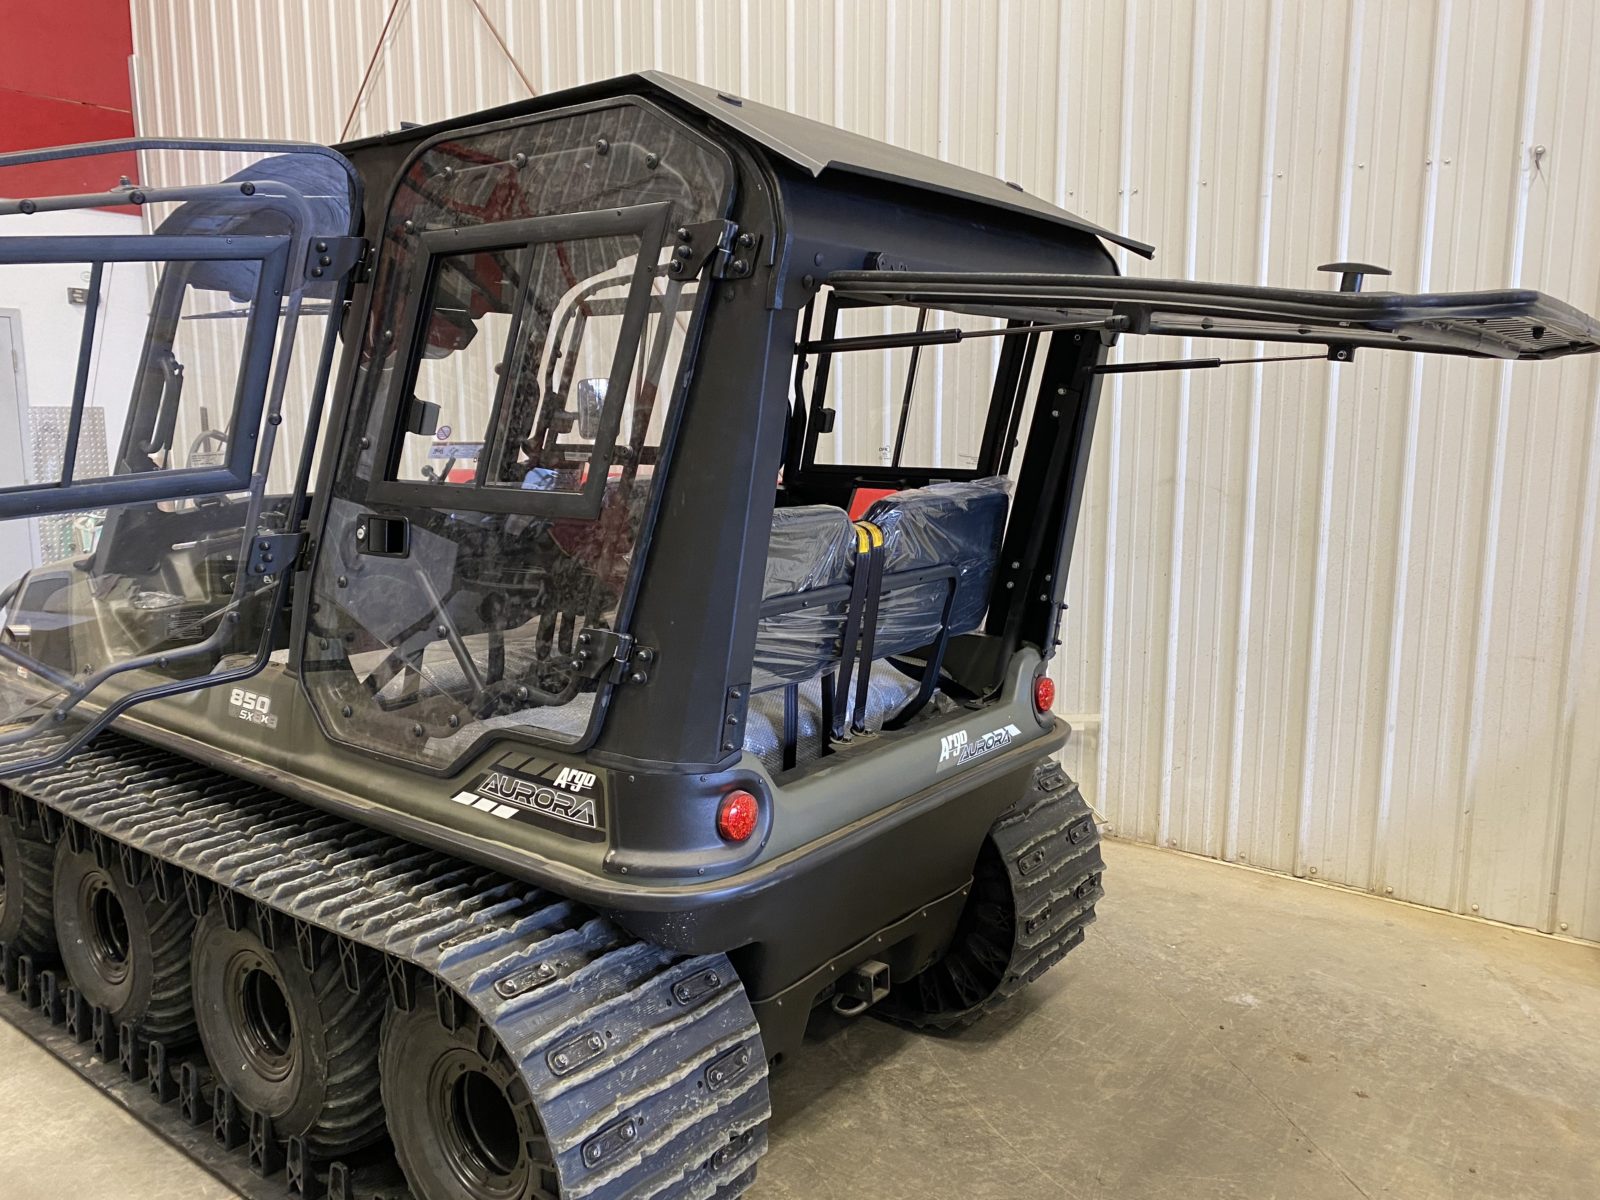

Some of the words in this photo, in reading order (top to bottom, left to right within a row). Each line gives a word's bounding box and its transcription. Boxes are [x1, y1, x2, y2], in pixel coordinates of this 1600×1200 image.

[230, 688, 271, 714] 850
[939, 729, 968, 763] Argo
[957, 730, 1011, 765] AURORA
[553, 767, 596, 793] Argo
[477, 772, 597, 828] AURORA
